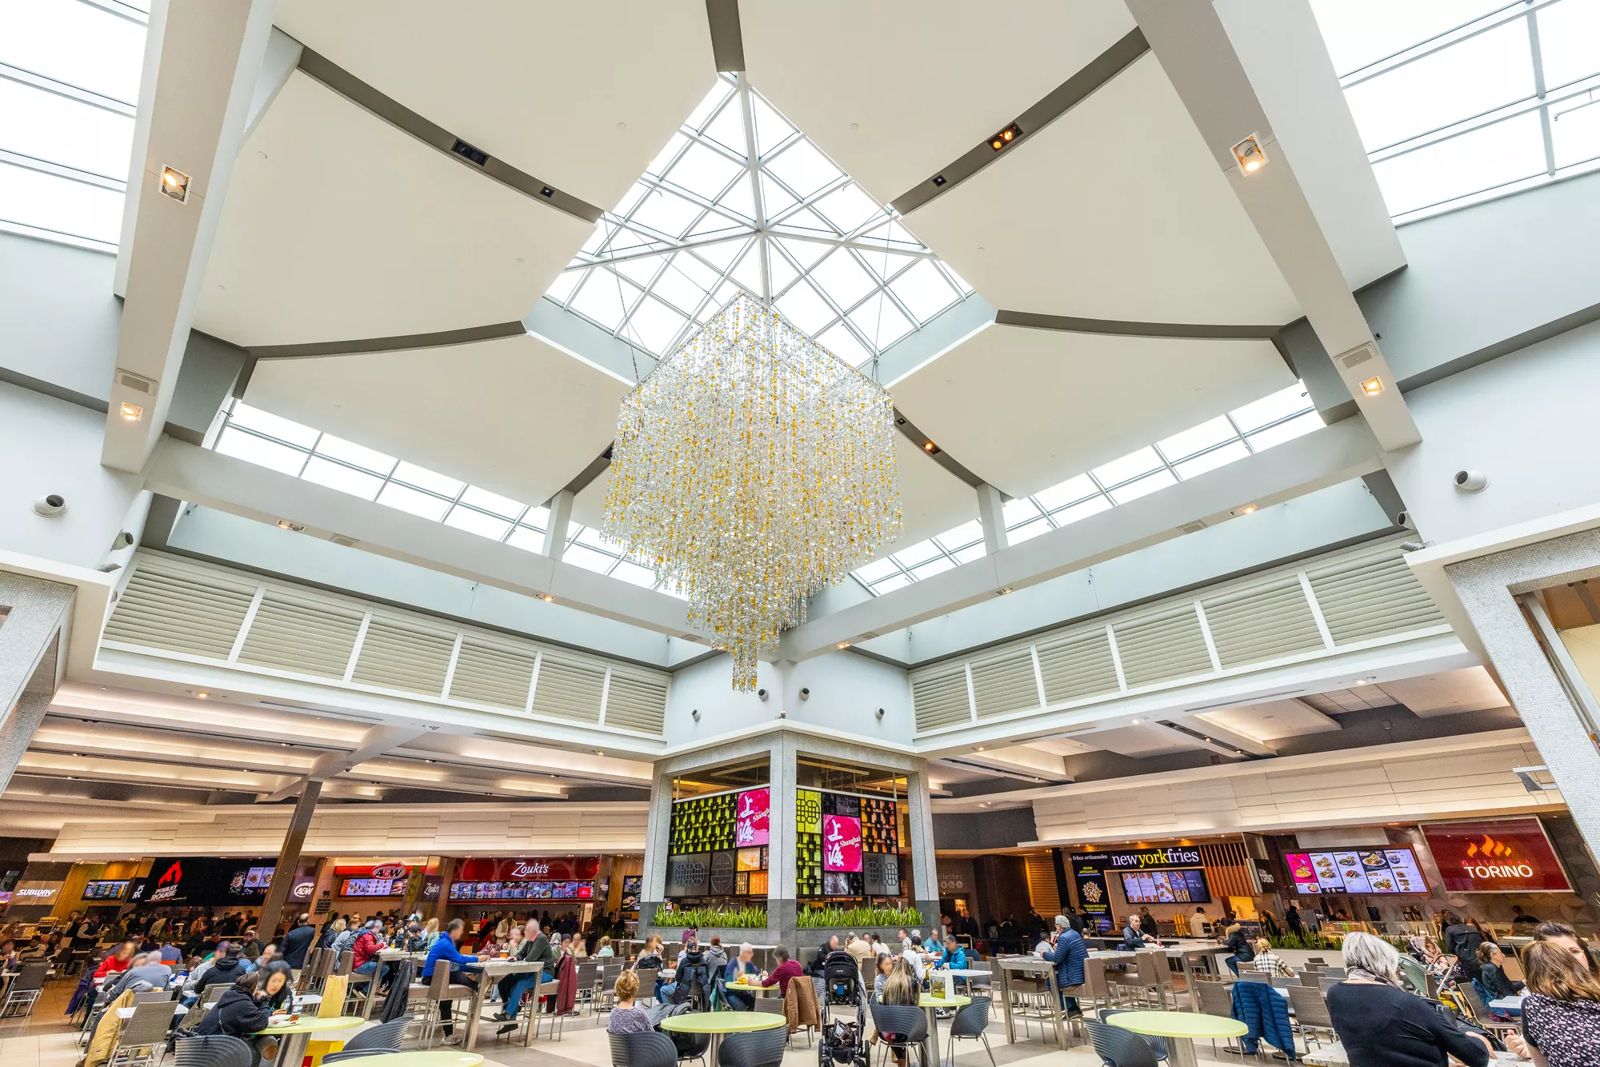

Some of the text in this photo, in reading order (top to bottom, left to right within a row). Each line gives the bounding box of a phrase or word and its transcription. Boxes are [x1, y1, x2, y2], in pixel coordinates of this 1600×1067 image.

[753, 808, 770, 823] Shangh
[839, 835, 861, 848] Shanghai
[375, 868, 403, 877] A&W
[511, 861, 549, 877] Zouki's
[1463, 864, 1534, 879] TORINO
[16, 889, 57, 898] SUBWAY
